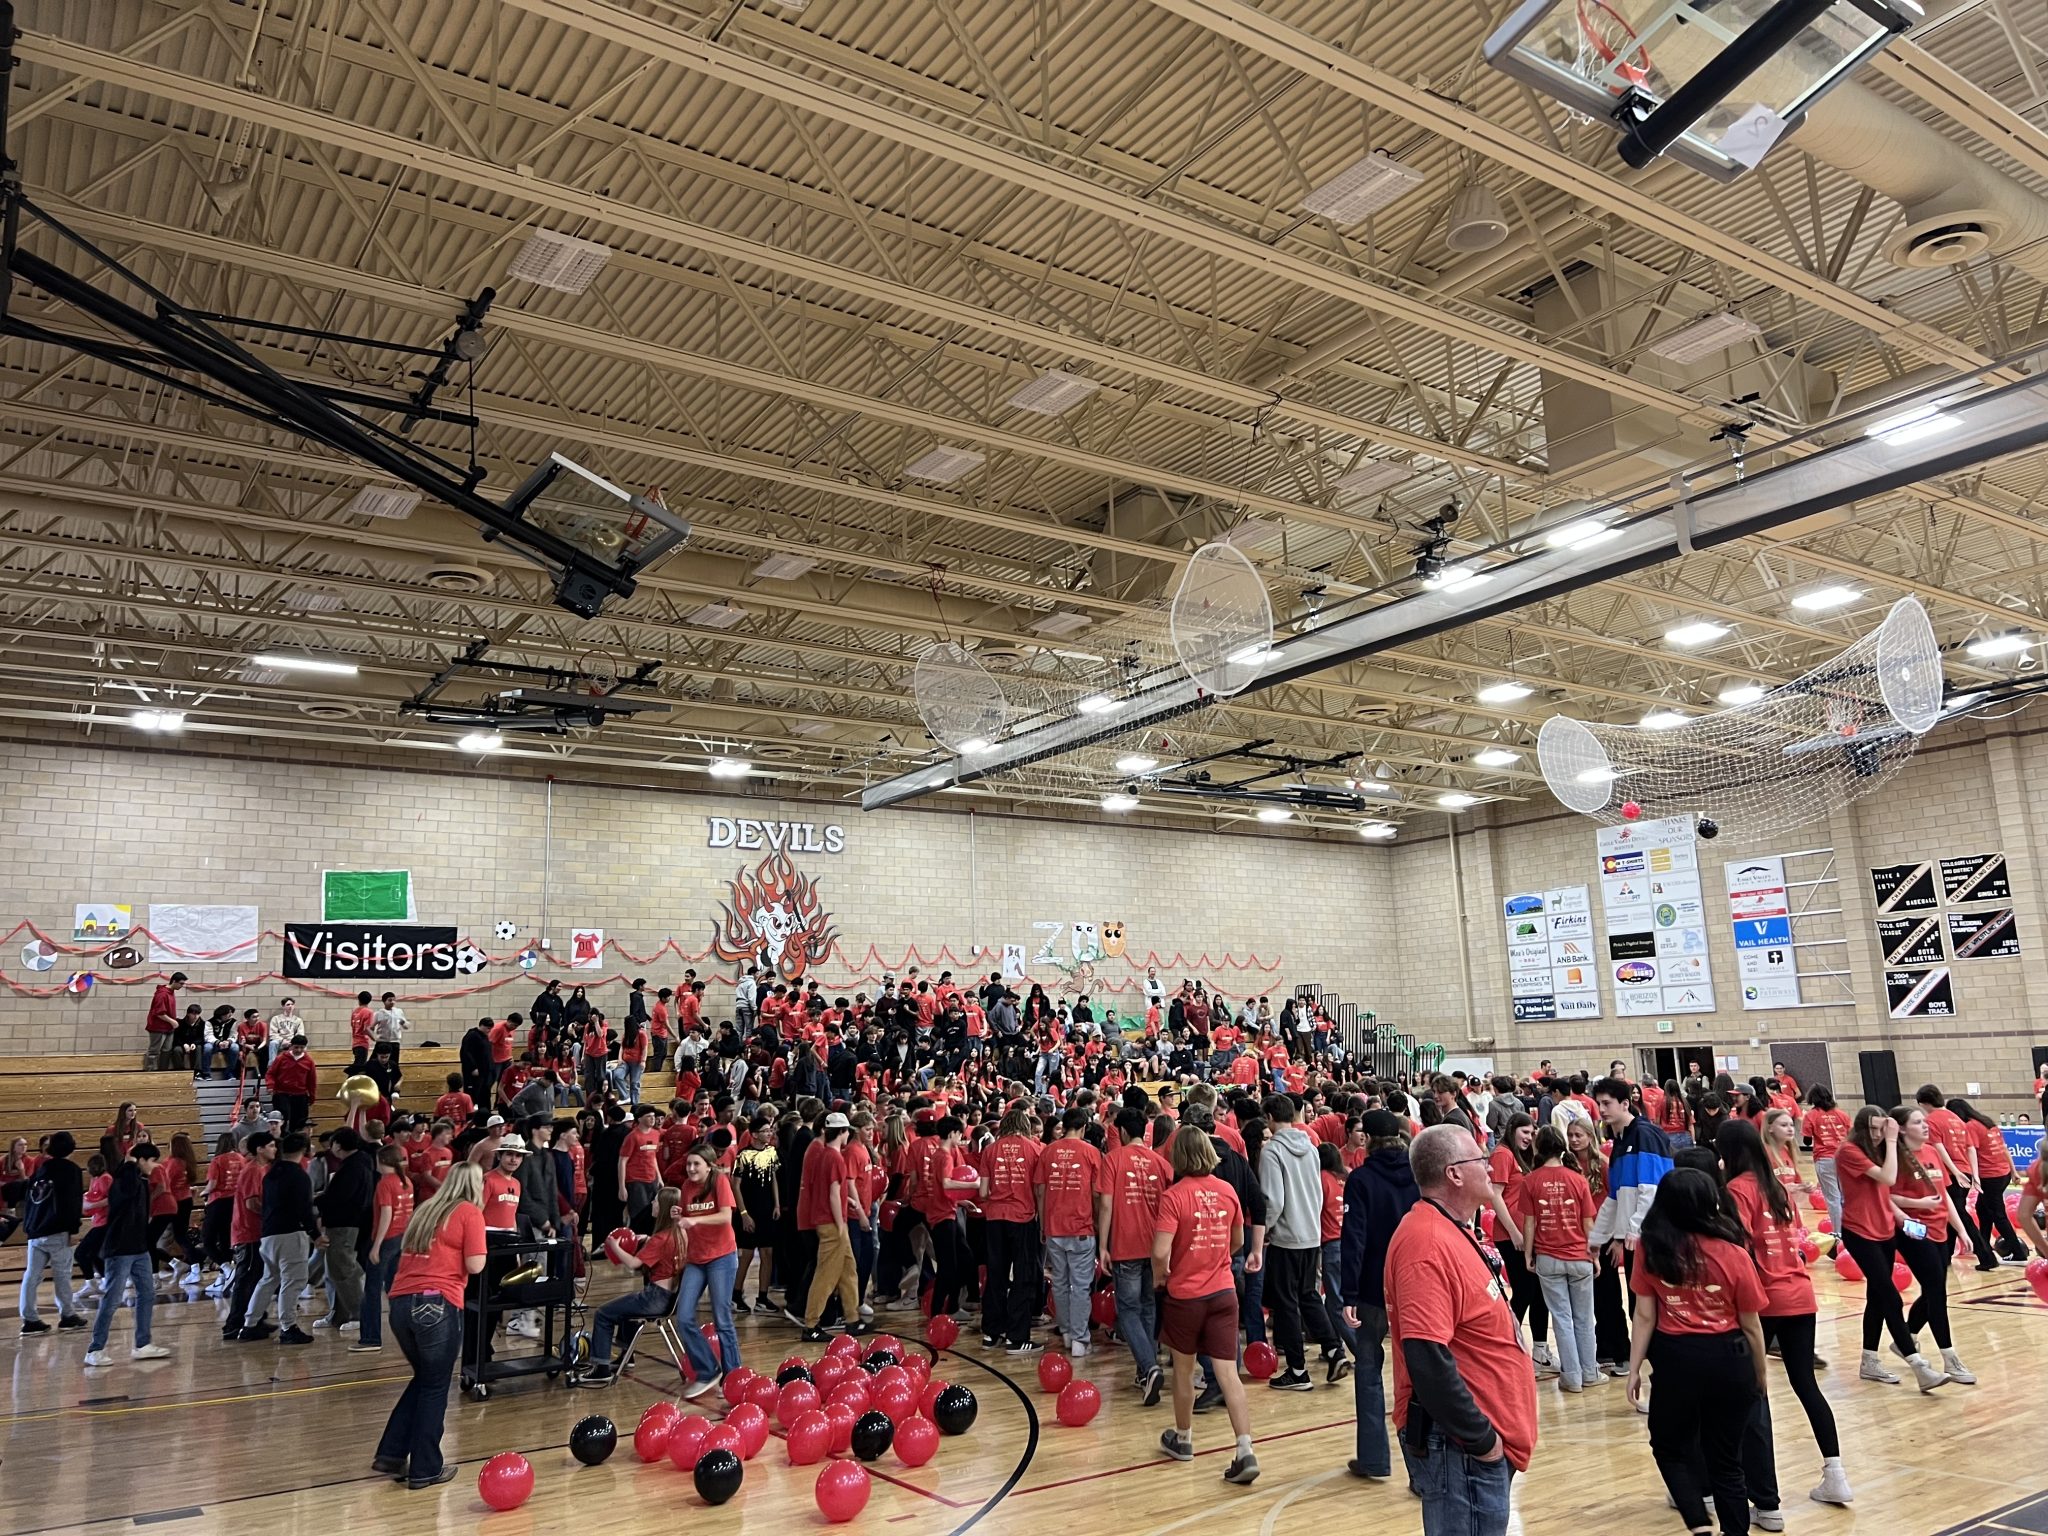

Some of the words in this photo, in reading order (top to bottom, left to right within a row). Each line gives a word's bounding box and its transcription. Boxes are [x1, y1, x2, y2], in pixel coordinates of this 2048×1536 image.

[709, 817, 845, 853] DEVILS
[1659, 834, 1694, 844] SPONSORS
[1891, 874, 1918, 902] CHAMPIONS
[1950, 890, 1964, 903] STATE
[1963, 868, 1987, 890] WRESTLING
[1905, 898, 1936, 906] BASEBALL
[1554, 915, 1587, 929] Firkins
[579, 940, 592, 951] 00
[1031, 921, 1126, 963] ZOO
[1757, 936, 1789, 945] HEALTH
[1888, 951, 1901, 964] STATE
[1901, 926, 1926, 951] CHAMPIONS
[288, 931, 455, 972] Visitors
[1525, 946, 1547, 956] Original
[1572, 955, 1588, 963] Bank
[1904, 954, 1943, 962] BASKETBALL
[1512, 976, 1551, 984] COLLETT
[1630, 992, 1658, 1000] HORIZON
[1902, 999, 1915, 1013] STATE
[1914, 973, 1938, 999] CHAMPIONS
[1525, 1005, 1542, 1013] Alpine
[1560, 1002, 1575, 1010] Vail
[1576, 1001, 1597, 1010] Daily
